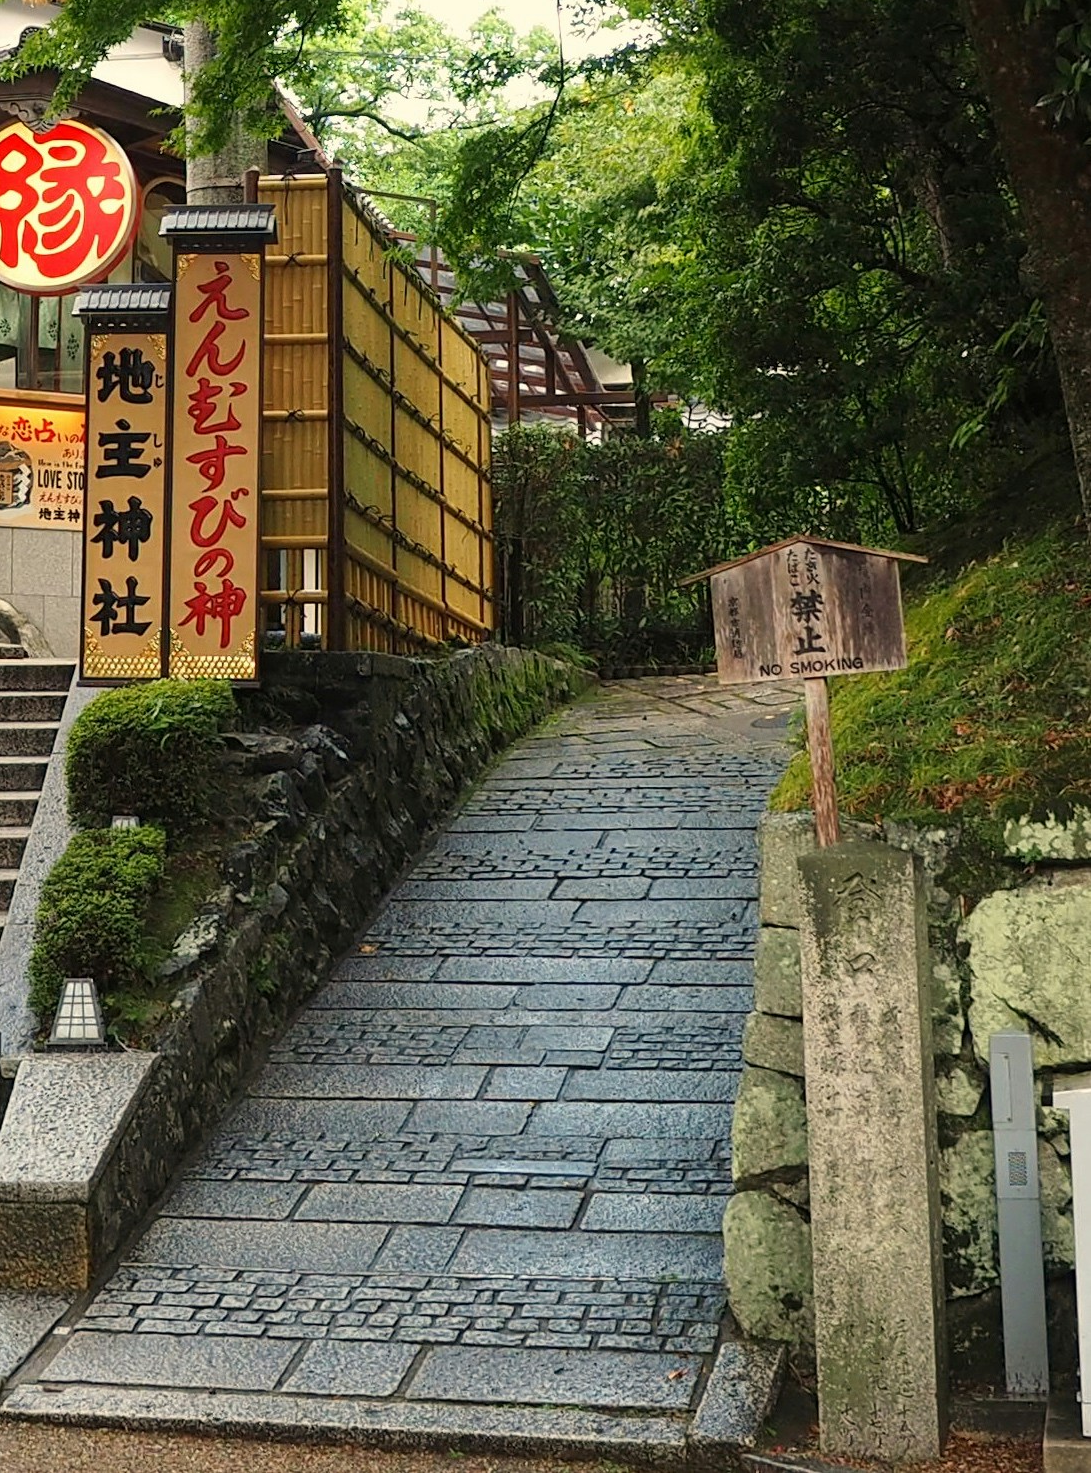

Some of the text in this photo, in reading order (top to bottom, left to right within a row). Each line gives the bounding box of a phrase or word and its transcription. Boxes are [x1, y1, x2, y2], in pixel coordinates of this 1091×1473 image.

[62, 448, 84, 460] あり
[177, 261, 250, 650] えんむすびの神
[38, 469, 62, 489] LOVE
[90, 346, 157, 638] 地主神社
[38, 507, 81, 523] 地主神
[790, 589, 827, 656] 禁止
[760, 657, 864, 677] NO SMOKING
